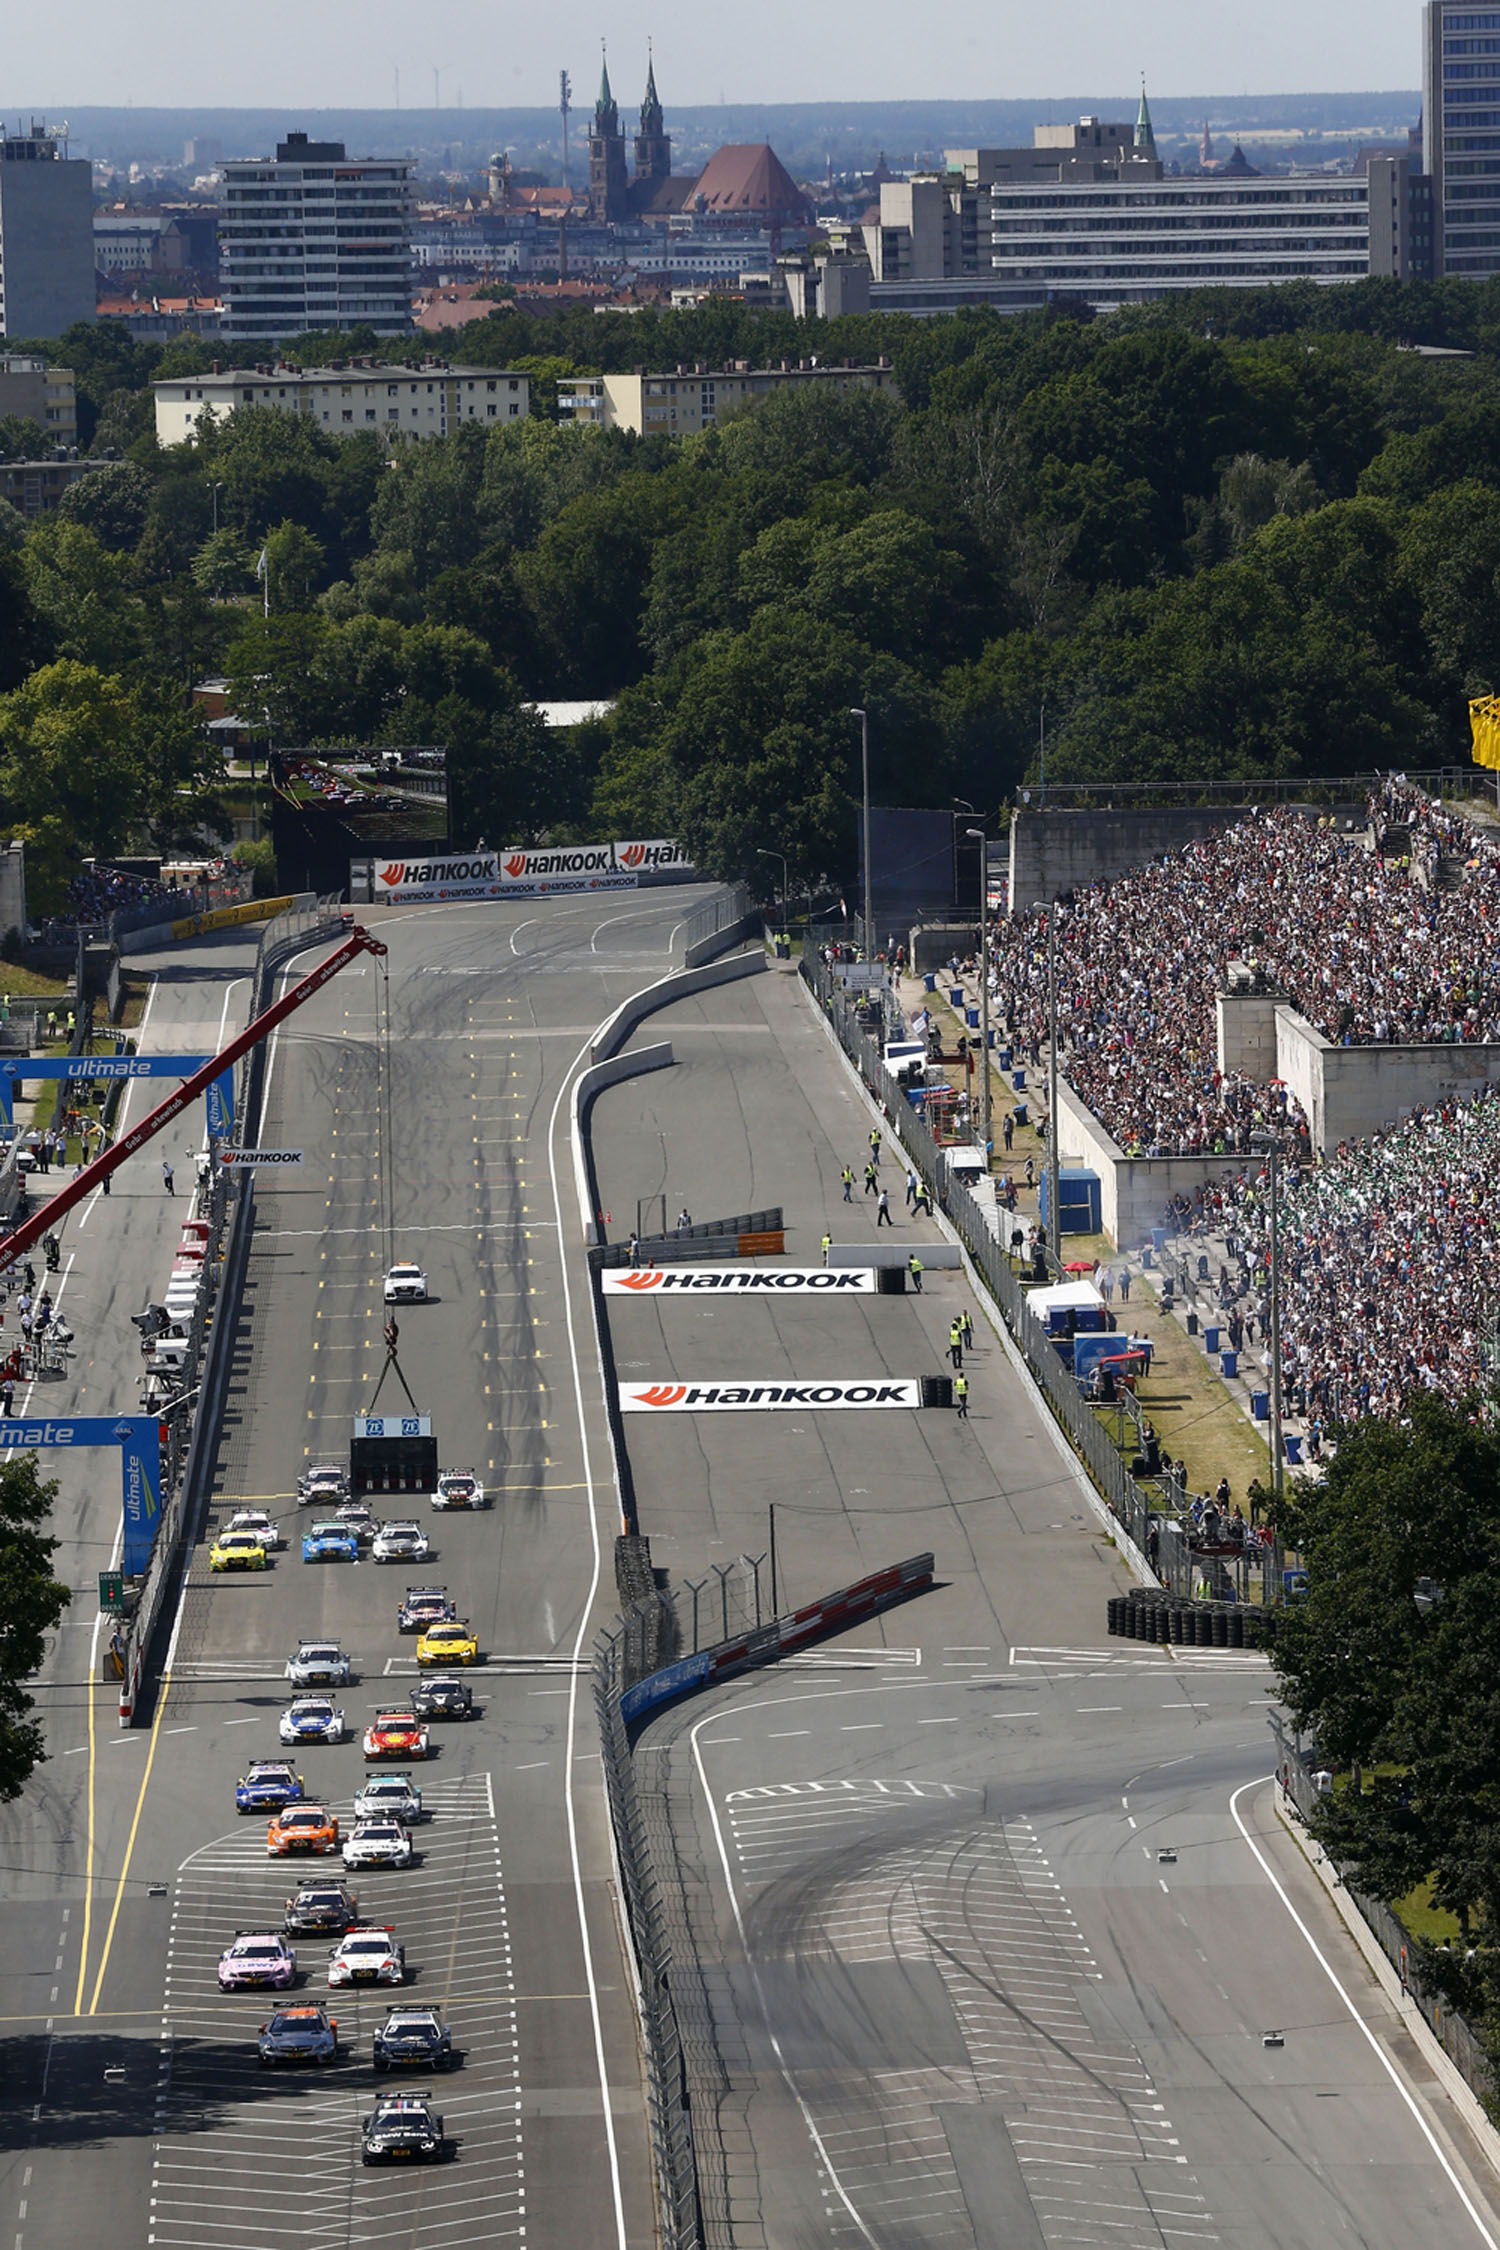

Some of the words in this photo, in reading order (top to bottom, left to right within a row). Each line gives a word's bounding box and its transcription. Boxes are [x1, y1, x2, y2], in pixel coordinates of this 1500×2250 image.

[68, 1060, 151, 1075] ultimate
[126, 1455, 141, 1521] ultimate
[375, 2132, 401, 2141] BMW
